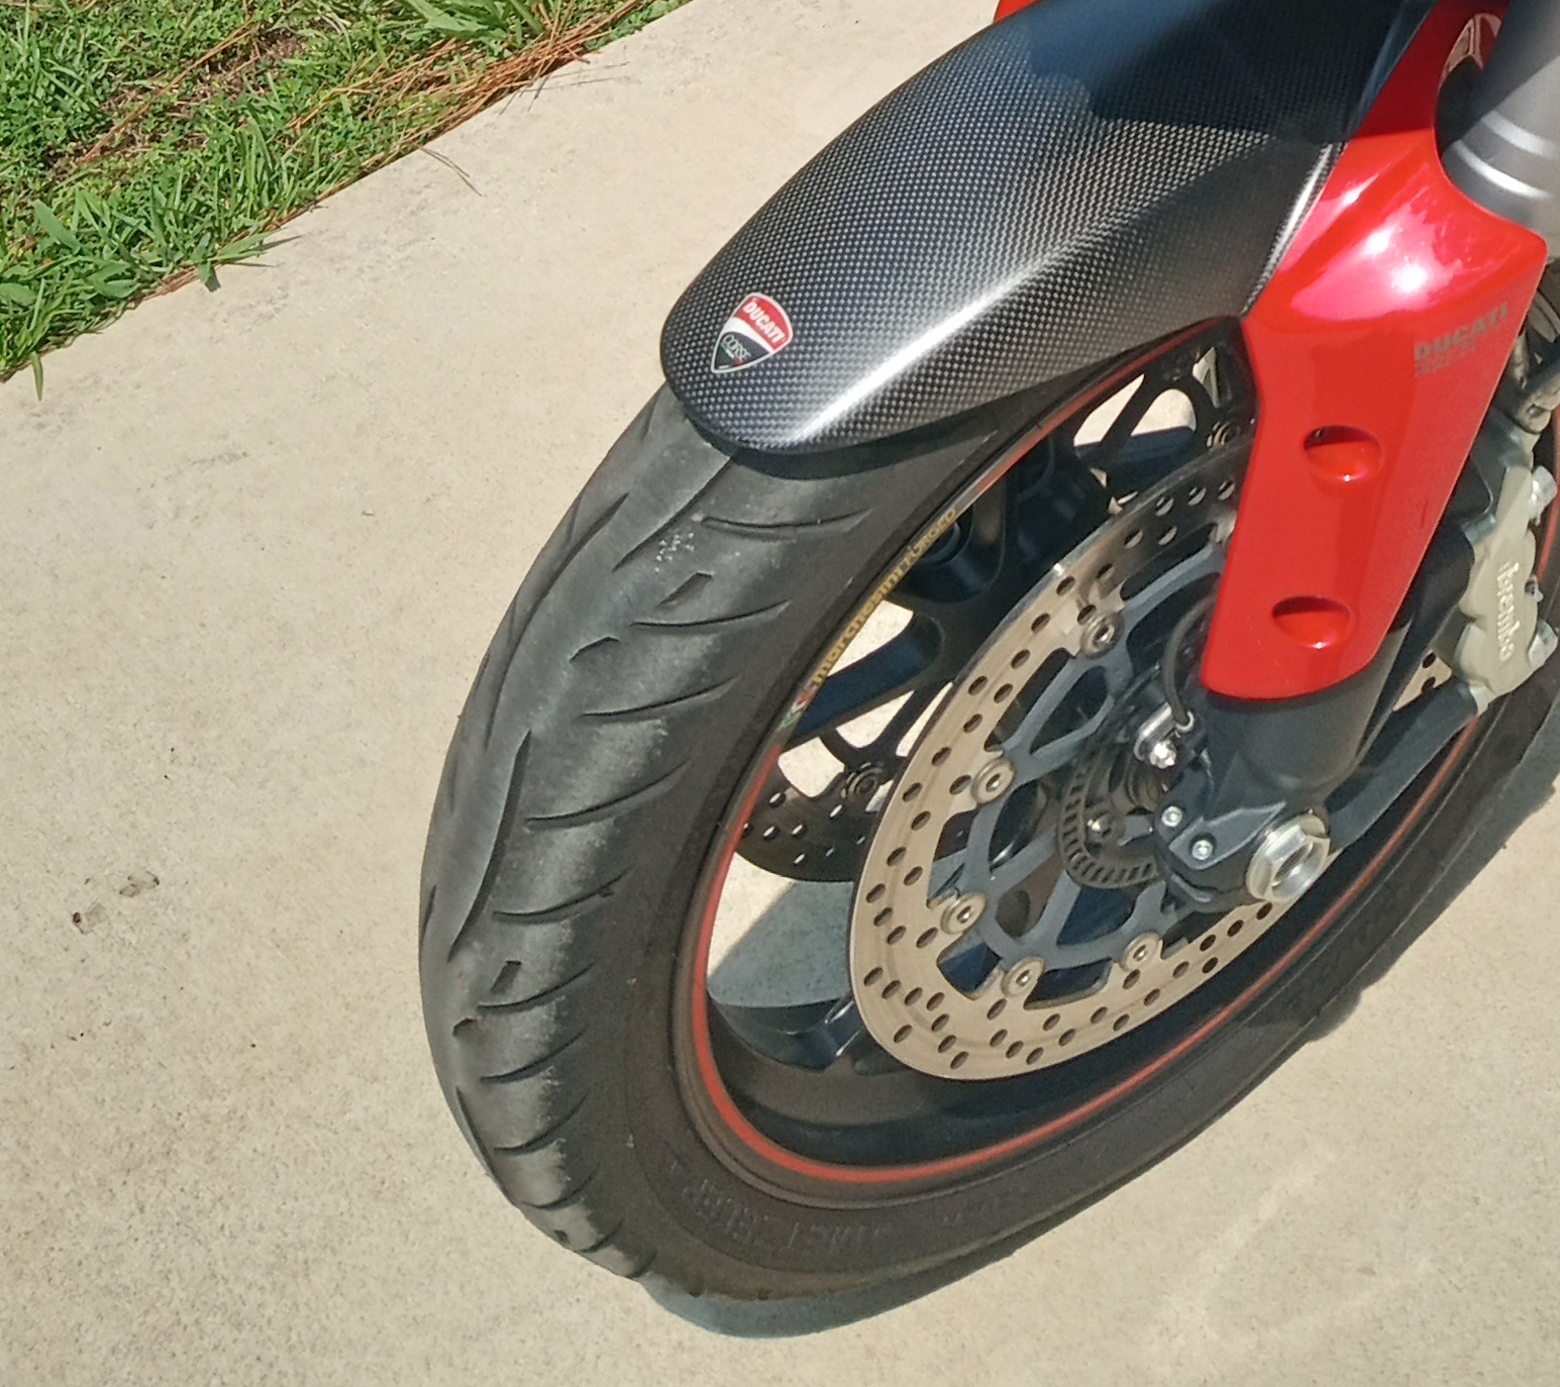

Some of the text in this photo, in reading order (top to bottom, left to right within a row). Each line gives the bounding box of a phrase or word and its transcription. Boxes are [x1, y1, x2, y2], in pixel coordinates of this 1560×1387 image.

[721, 334, 752, 360] CORSE
[742, 300, 785, 344] DUCATI
[1415, 303, 1508, 361] DUCATI
[811, 566, 903, 687] marchesini
